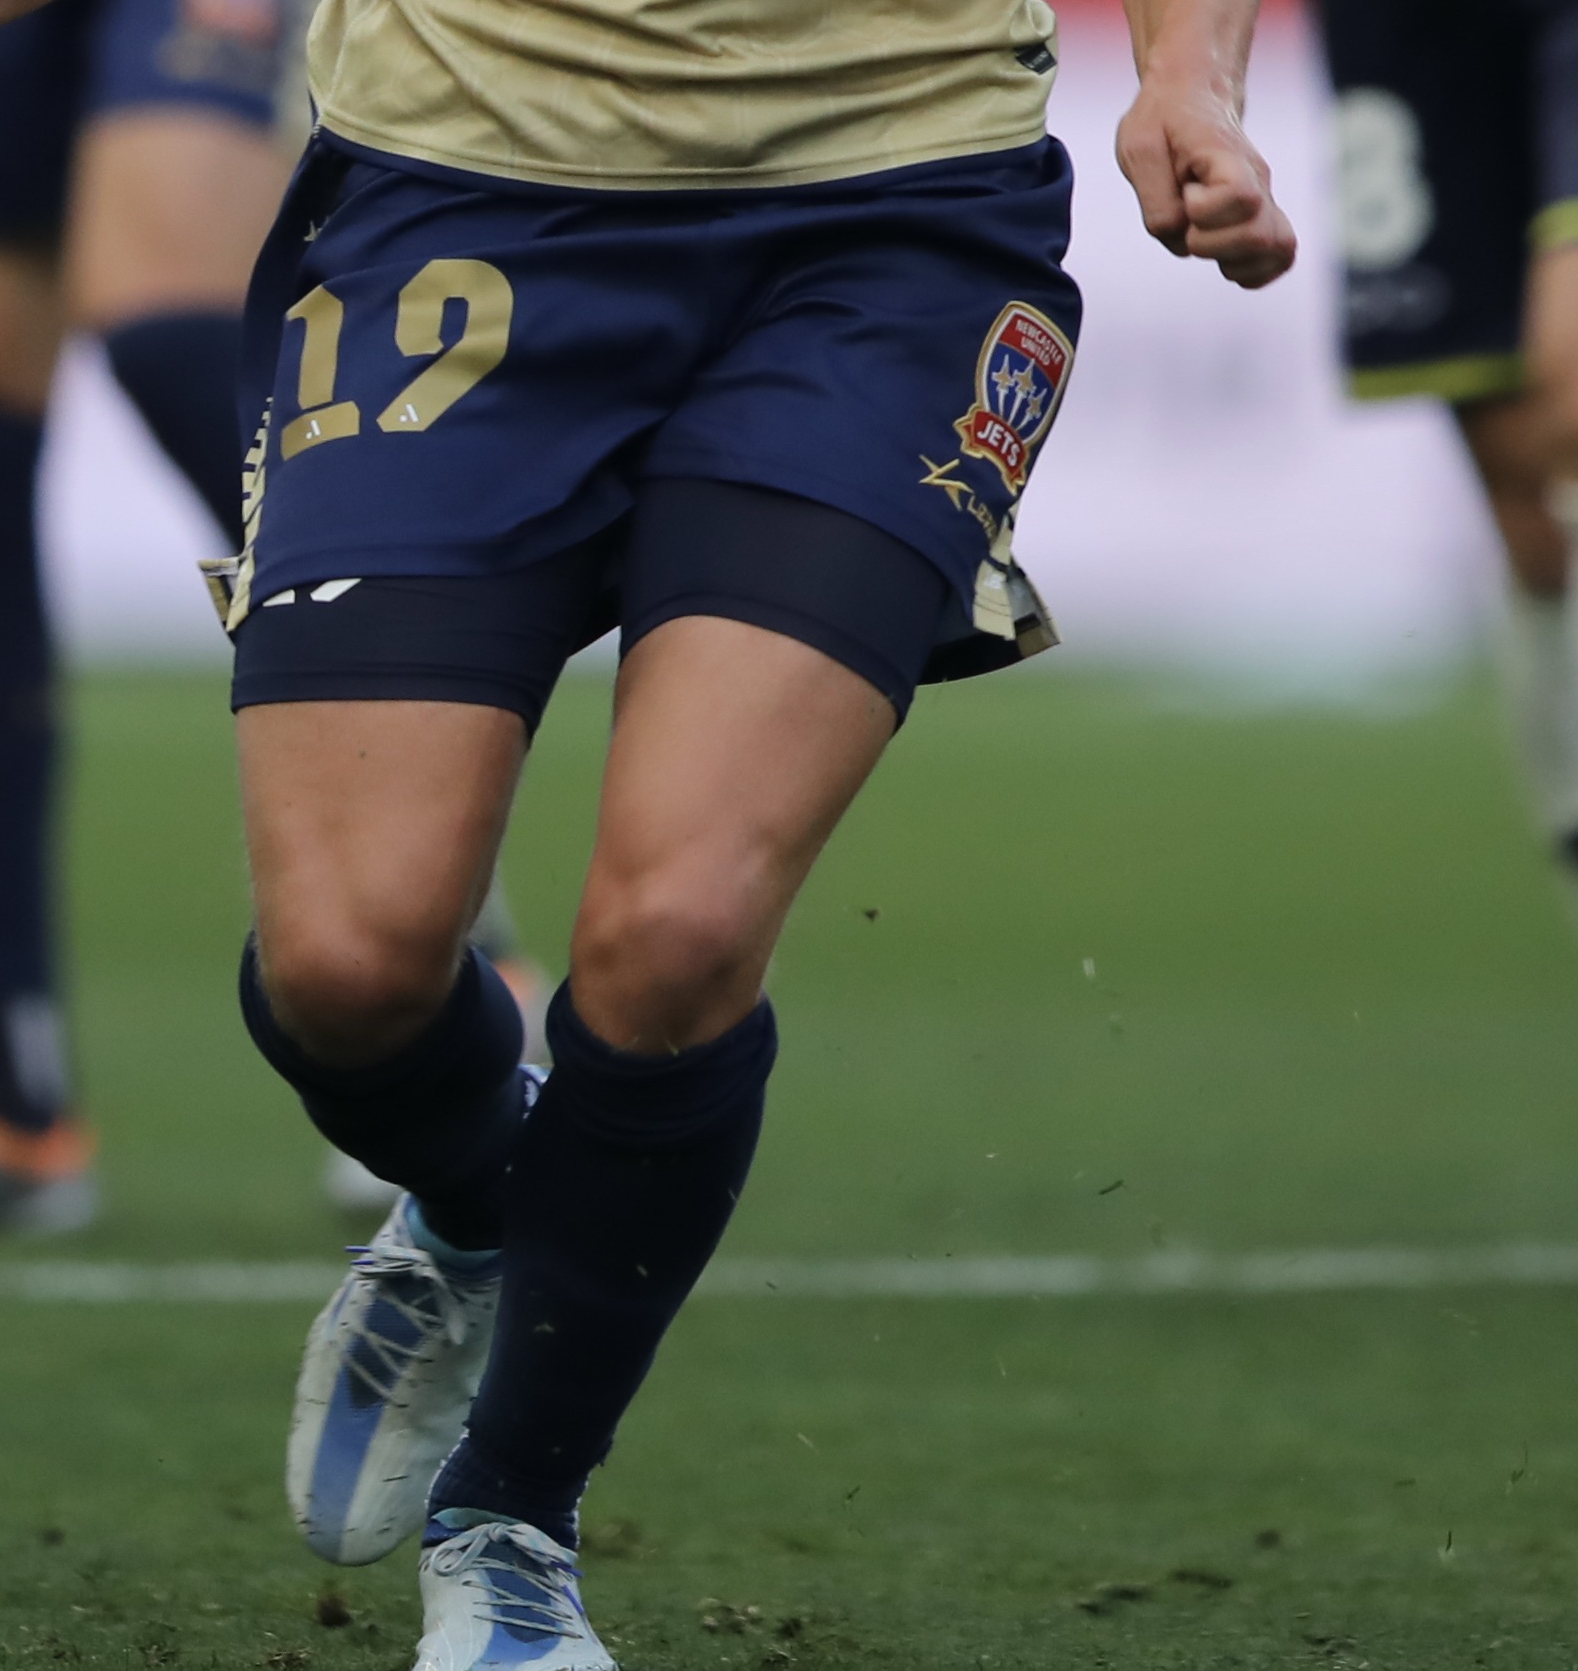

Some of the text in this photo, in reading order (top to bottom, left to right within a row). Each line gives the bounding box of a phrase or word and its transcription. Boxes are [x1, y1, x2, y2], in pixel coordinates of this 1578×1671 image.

[1015, 319, 1063, 365] NEWCASTLE
[1021, 336, 1051, 366] UNITED
[976, 420, 1021, 467] JETS
